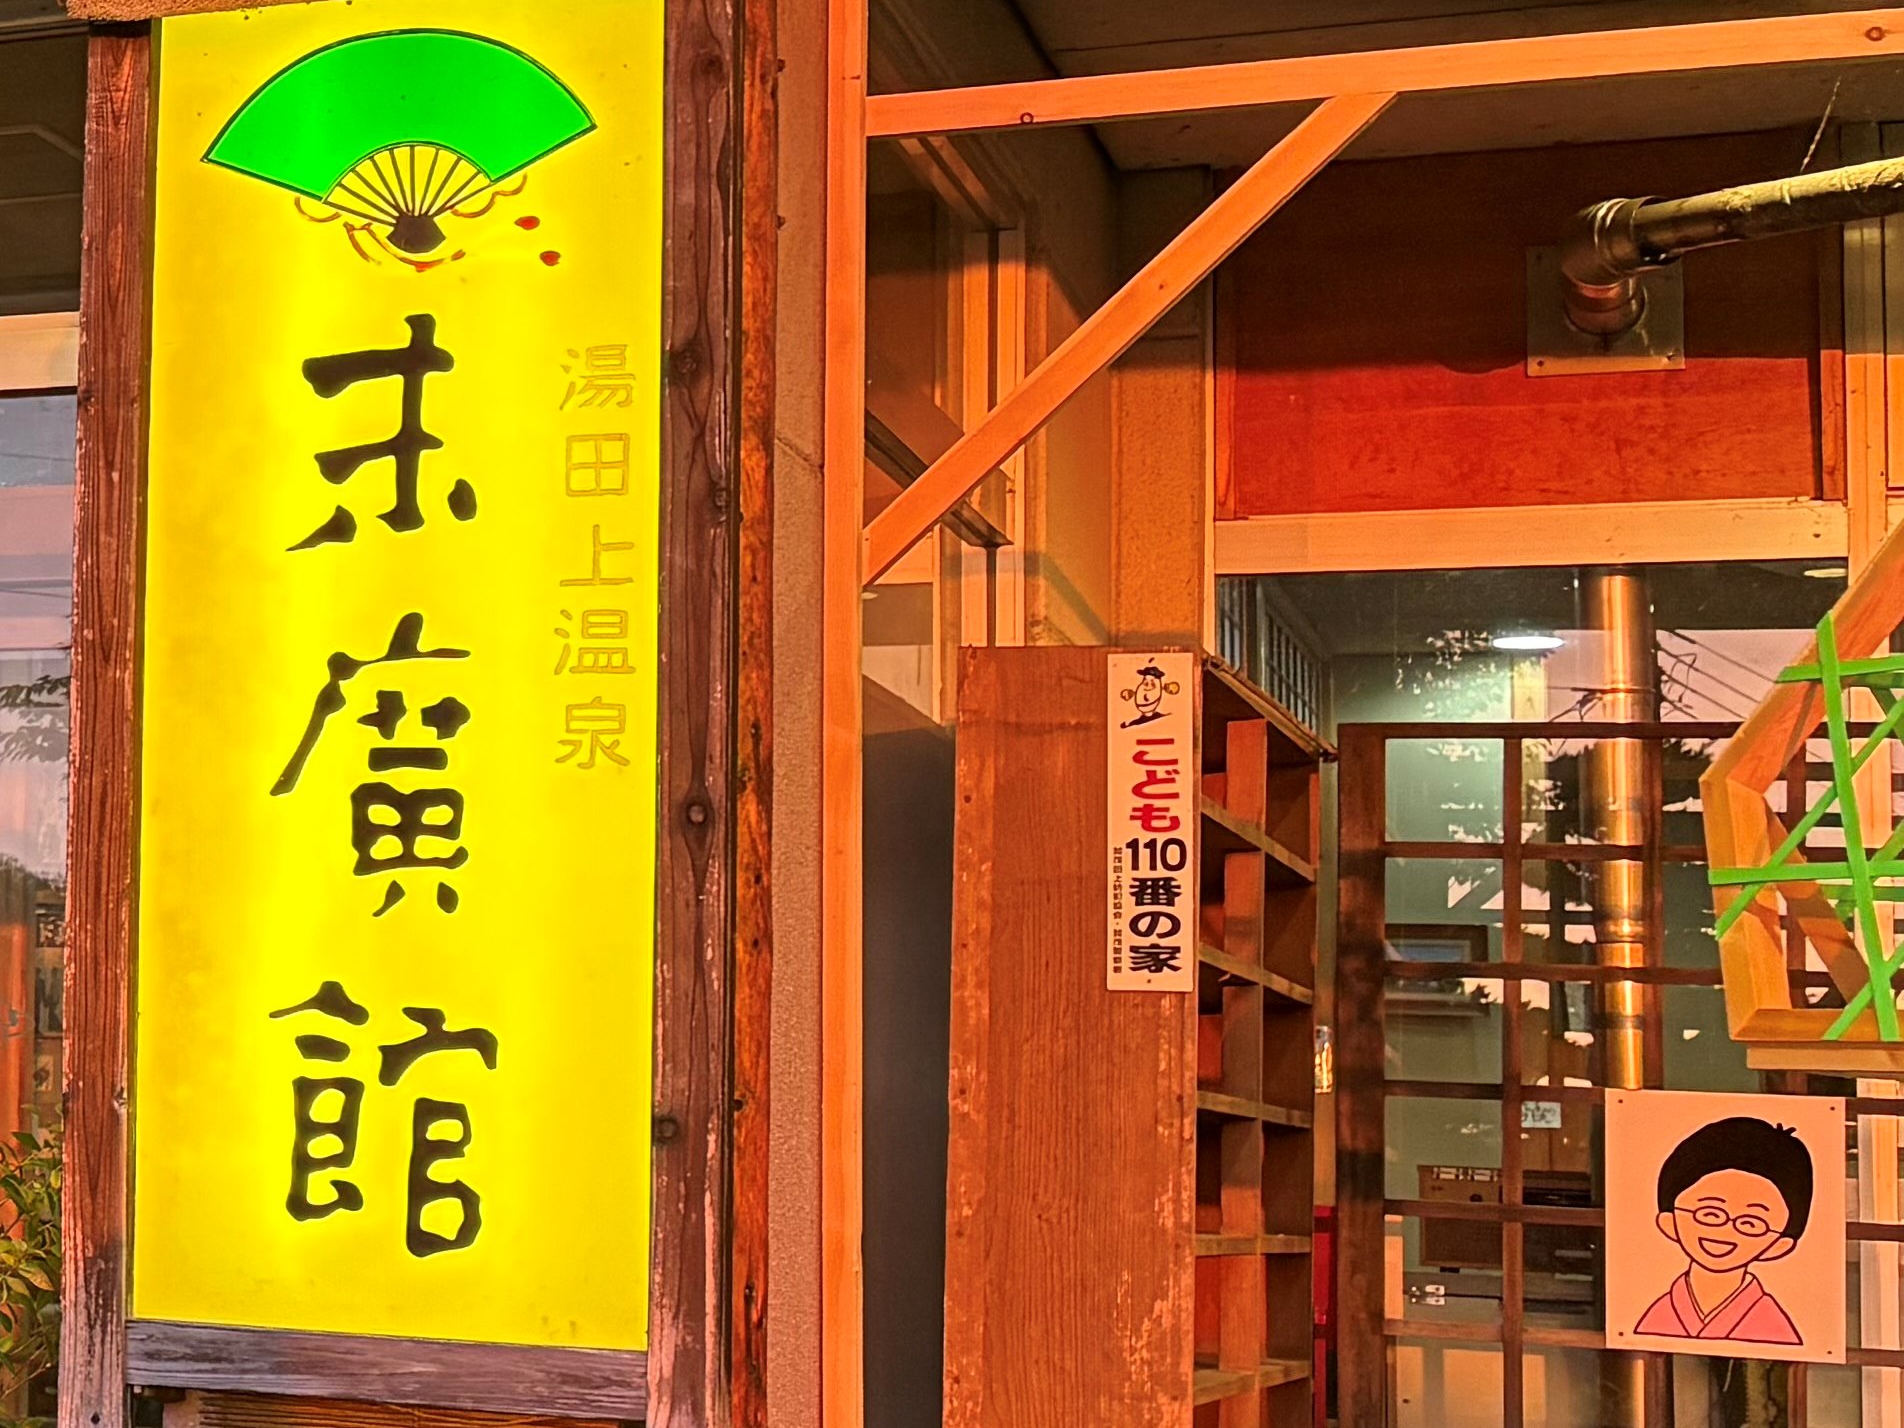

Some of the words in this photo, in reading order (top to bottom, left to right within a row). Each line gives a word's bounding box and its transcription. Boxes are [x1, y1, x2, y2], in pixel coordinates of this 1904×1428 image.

[554, 344, 636, 769] 湯田上温泉
[269, 312, 500, 1258] 末廣館
[1125, 738, 1188, 974] こども110番の家
